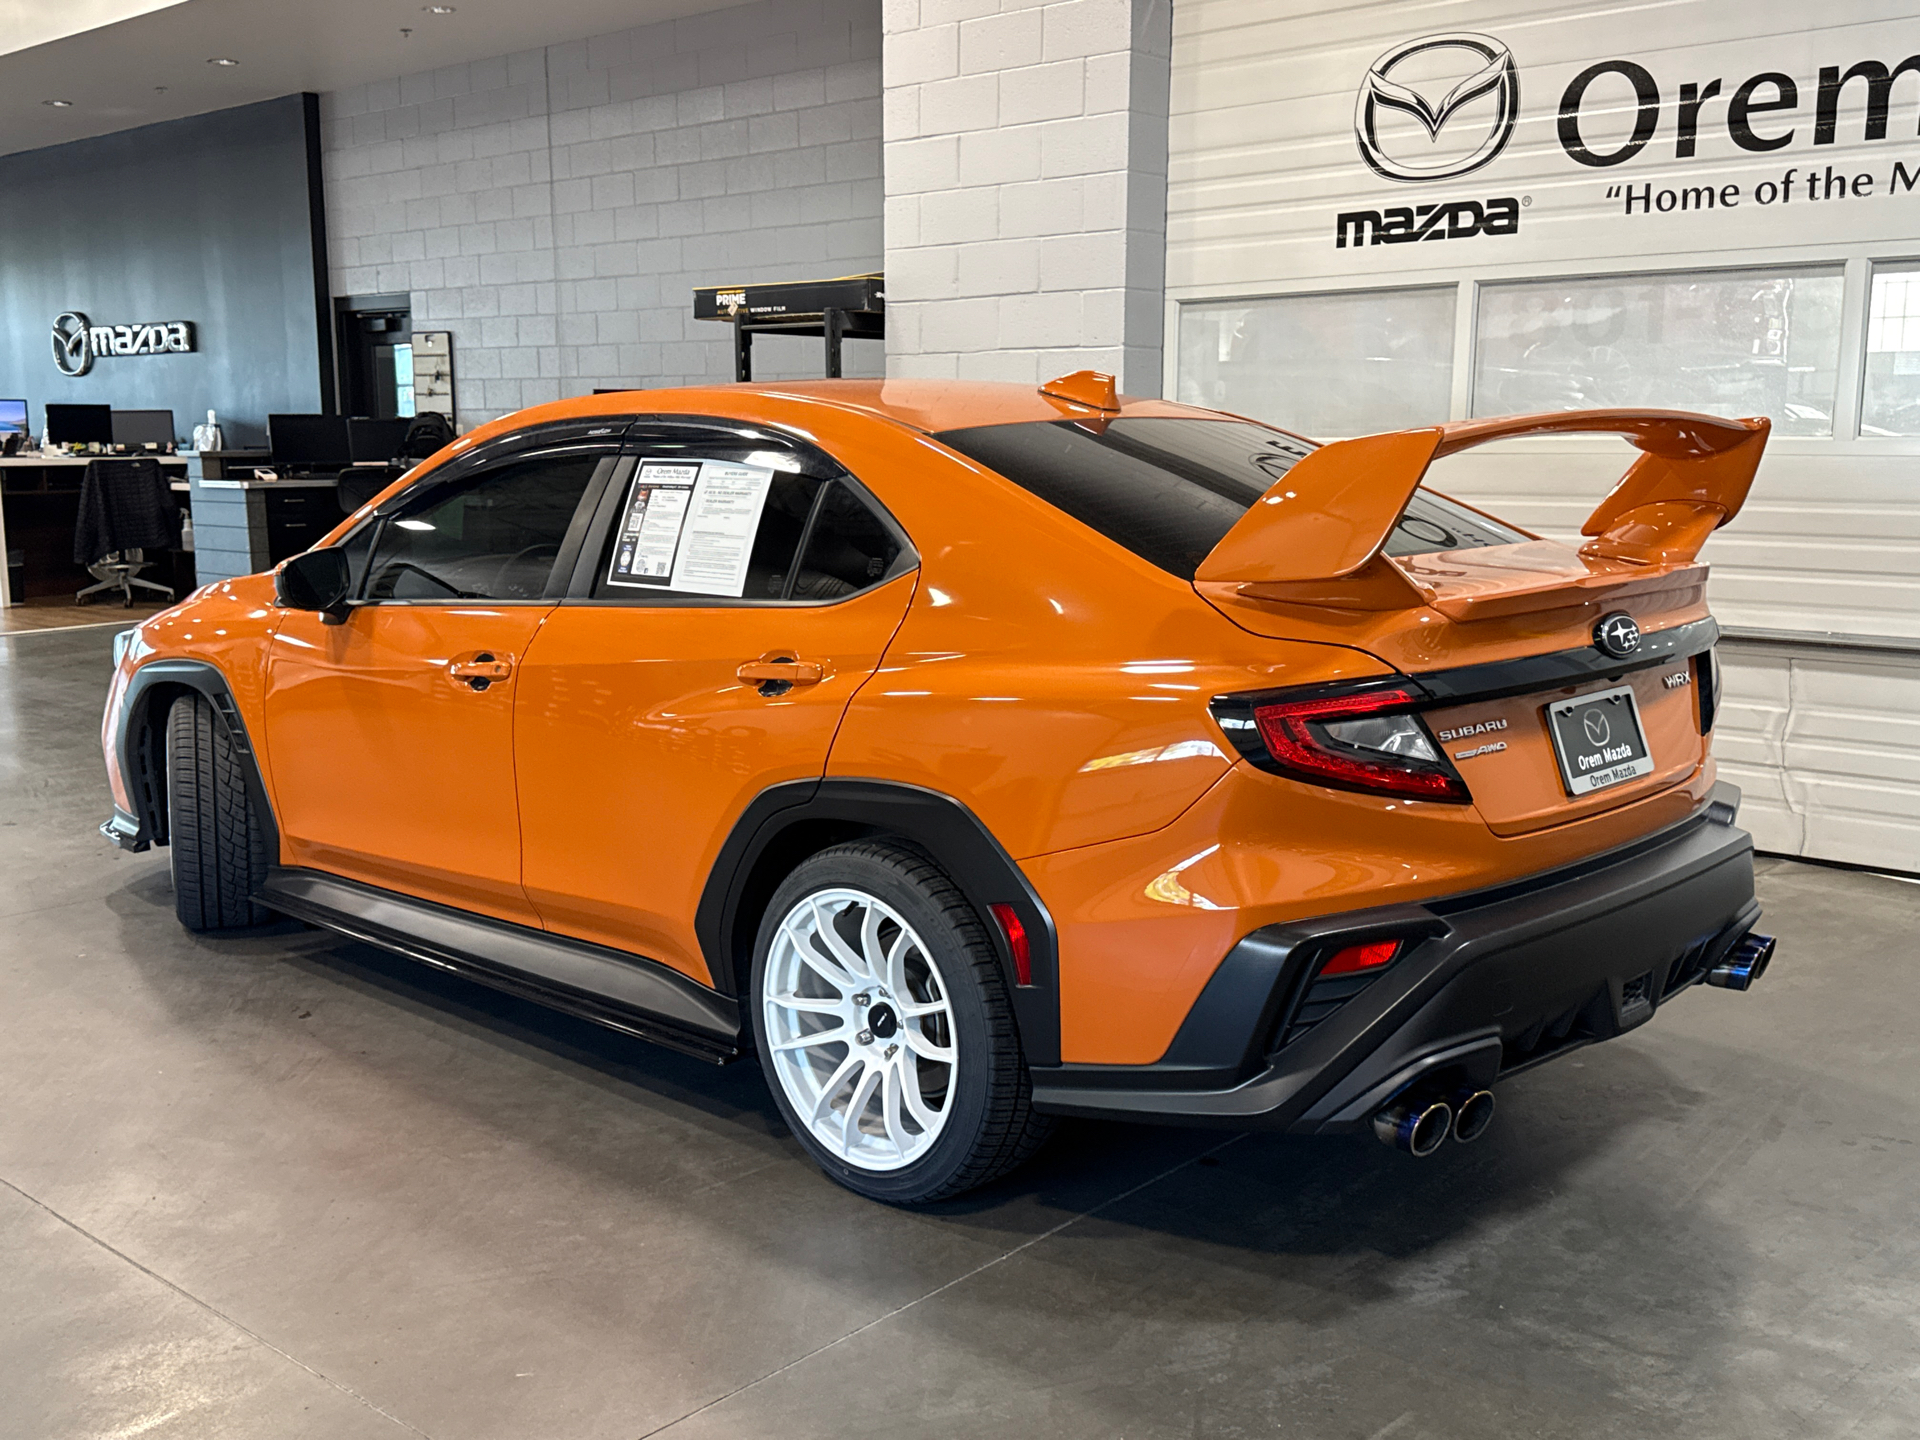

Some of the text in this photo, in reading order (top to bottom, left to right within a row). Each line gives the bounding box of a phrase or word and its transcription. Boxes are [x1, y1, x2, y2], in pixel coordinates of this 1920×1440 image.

[1557, 54, 1920, 167] Orem
[1755, 169, 1797, 205] of
[1806, 166, 1873, 202] the
[716, 293, 746, 306] PRIME
[1664, 670, 1692, 688] WRX
[1439, 719, 1508, 741] SUBARU
[1477, 741, 1508, 756] AWD
[1577, 742, 1633, 771] Orem Mazda
[1589, 764, 1637, 788] Orem Mazda
